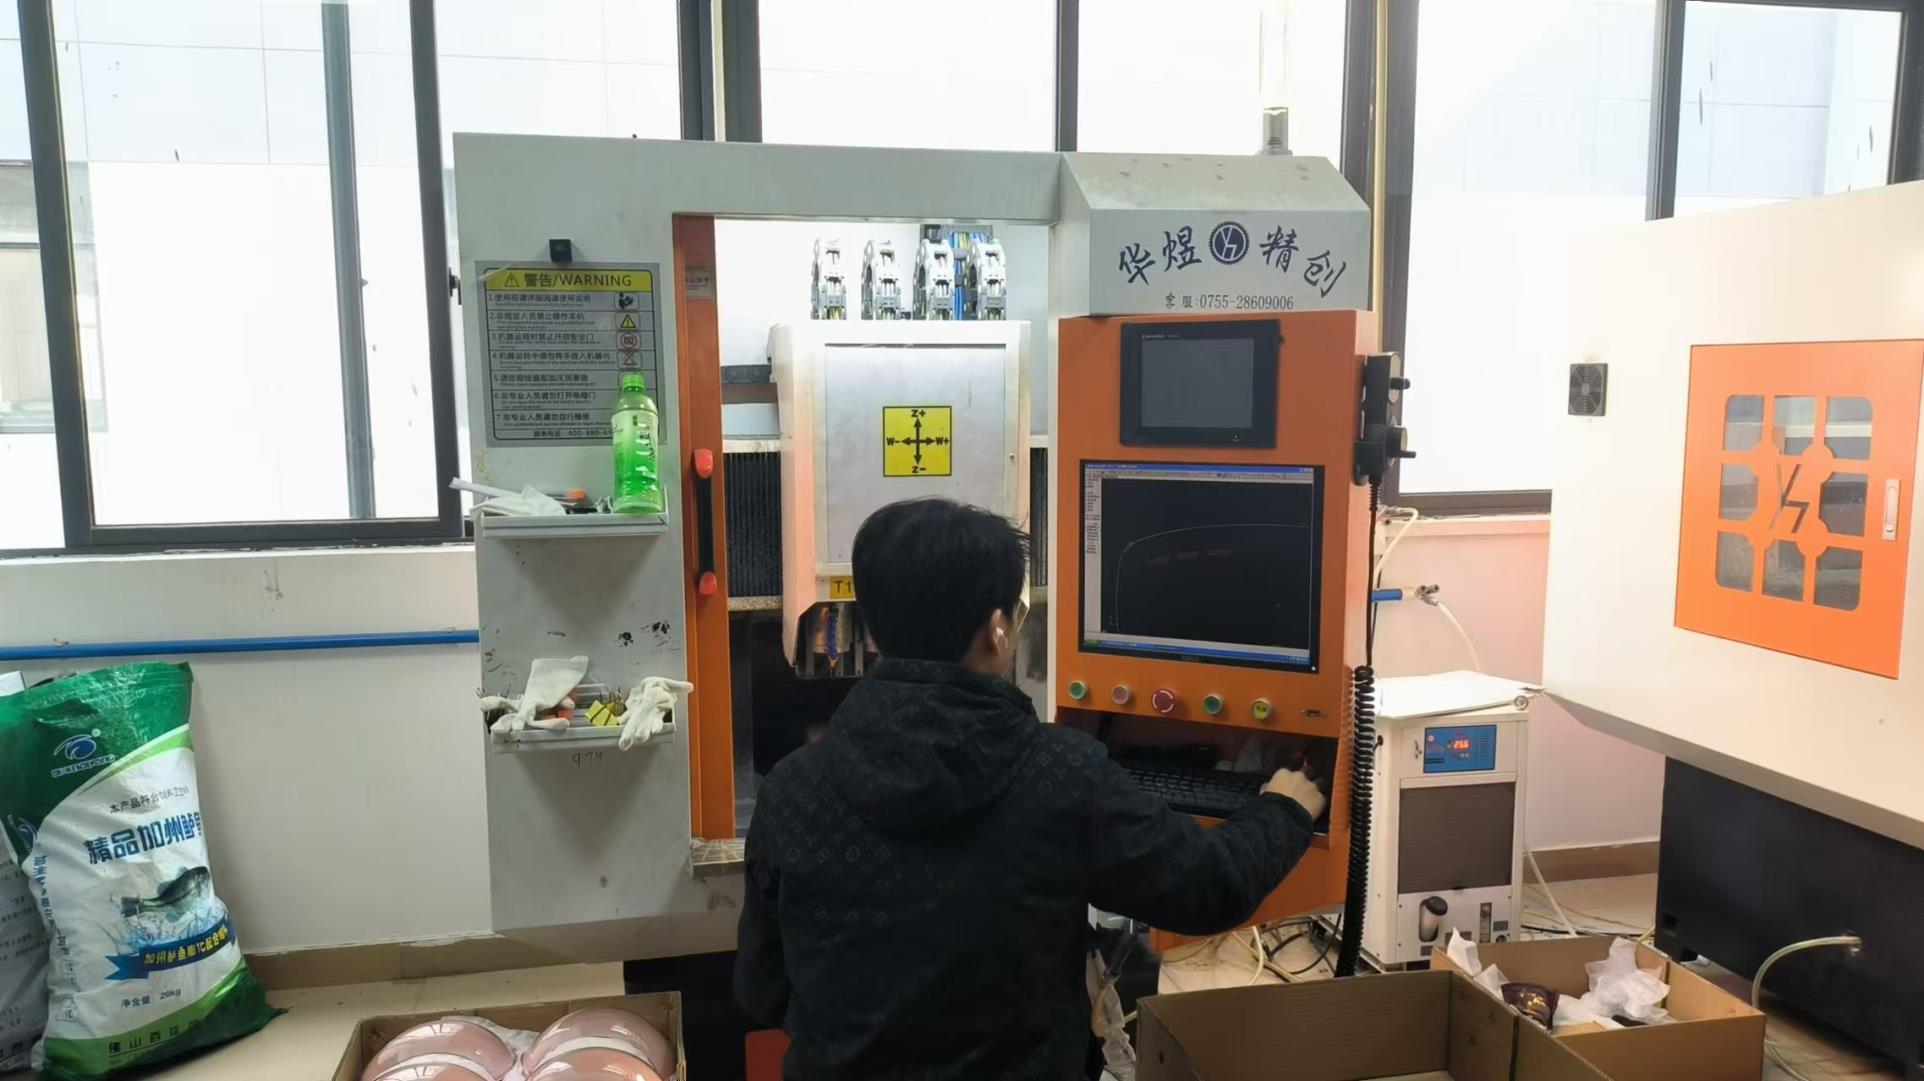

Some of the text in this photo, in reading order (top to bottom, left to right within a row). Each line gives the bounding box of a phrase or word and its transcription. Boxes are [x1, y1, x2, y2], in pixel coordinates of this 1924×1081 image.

[524, 273, 632, 287] 警告/WARNING
[1118, 225, 1347, 298] 华煜 精创
